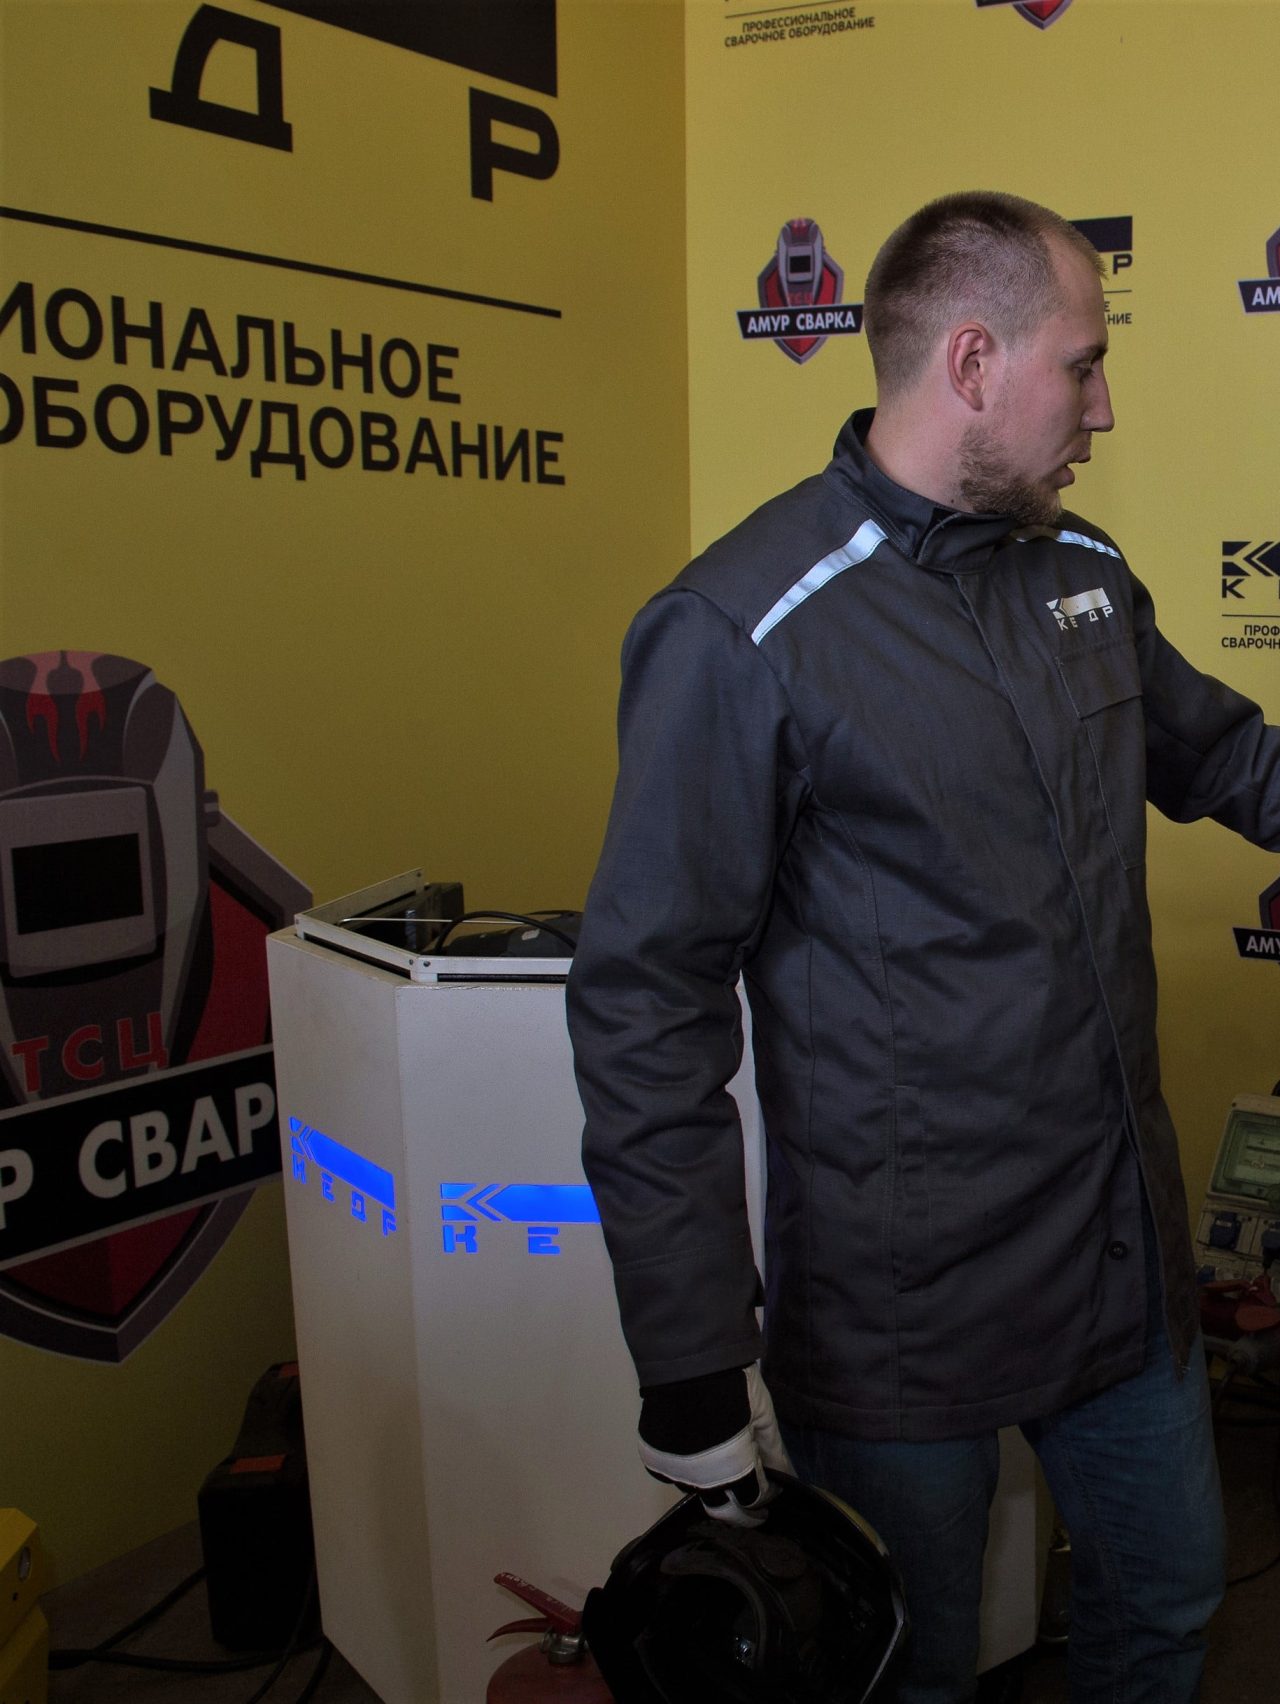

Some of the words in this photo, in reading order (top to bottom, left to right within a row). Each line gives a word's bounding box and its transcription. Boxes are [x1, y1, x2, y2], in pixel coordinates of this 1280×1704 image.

[725, 28, 786, 47] СВАРОЧНОЕ
[789, 16, 875, 38] ОБОРУДОВАНИЕ
[742, 7, 856, 32] ПРОФЕССИОНАЛЬНОЕ
[747, 314, 791, 334] АМУР
[795, 310, 856, 331] СВАРКА
[11, 1011, 169, 1093] ТСЦ
[78, 1082, 276, 1200] СВАР
[292, 1153, 397, 1236] КЕДР
[442, 1225, 560, 1255] КЕ
